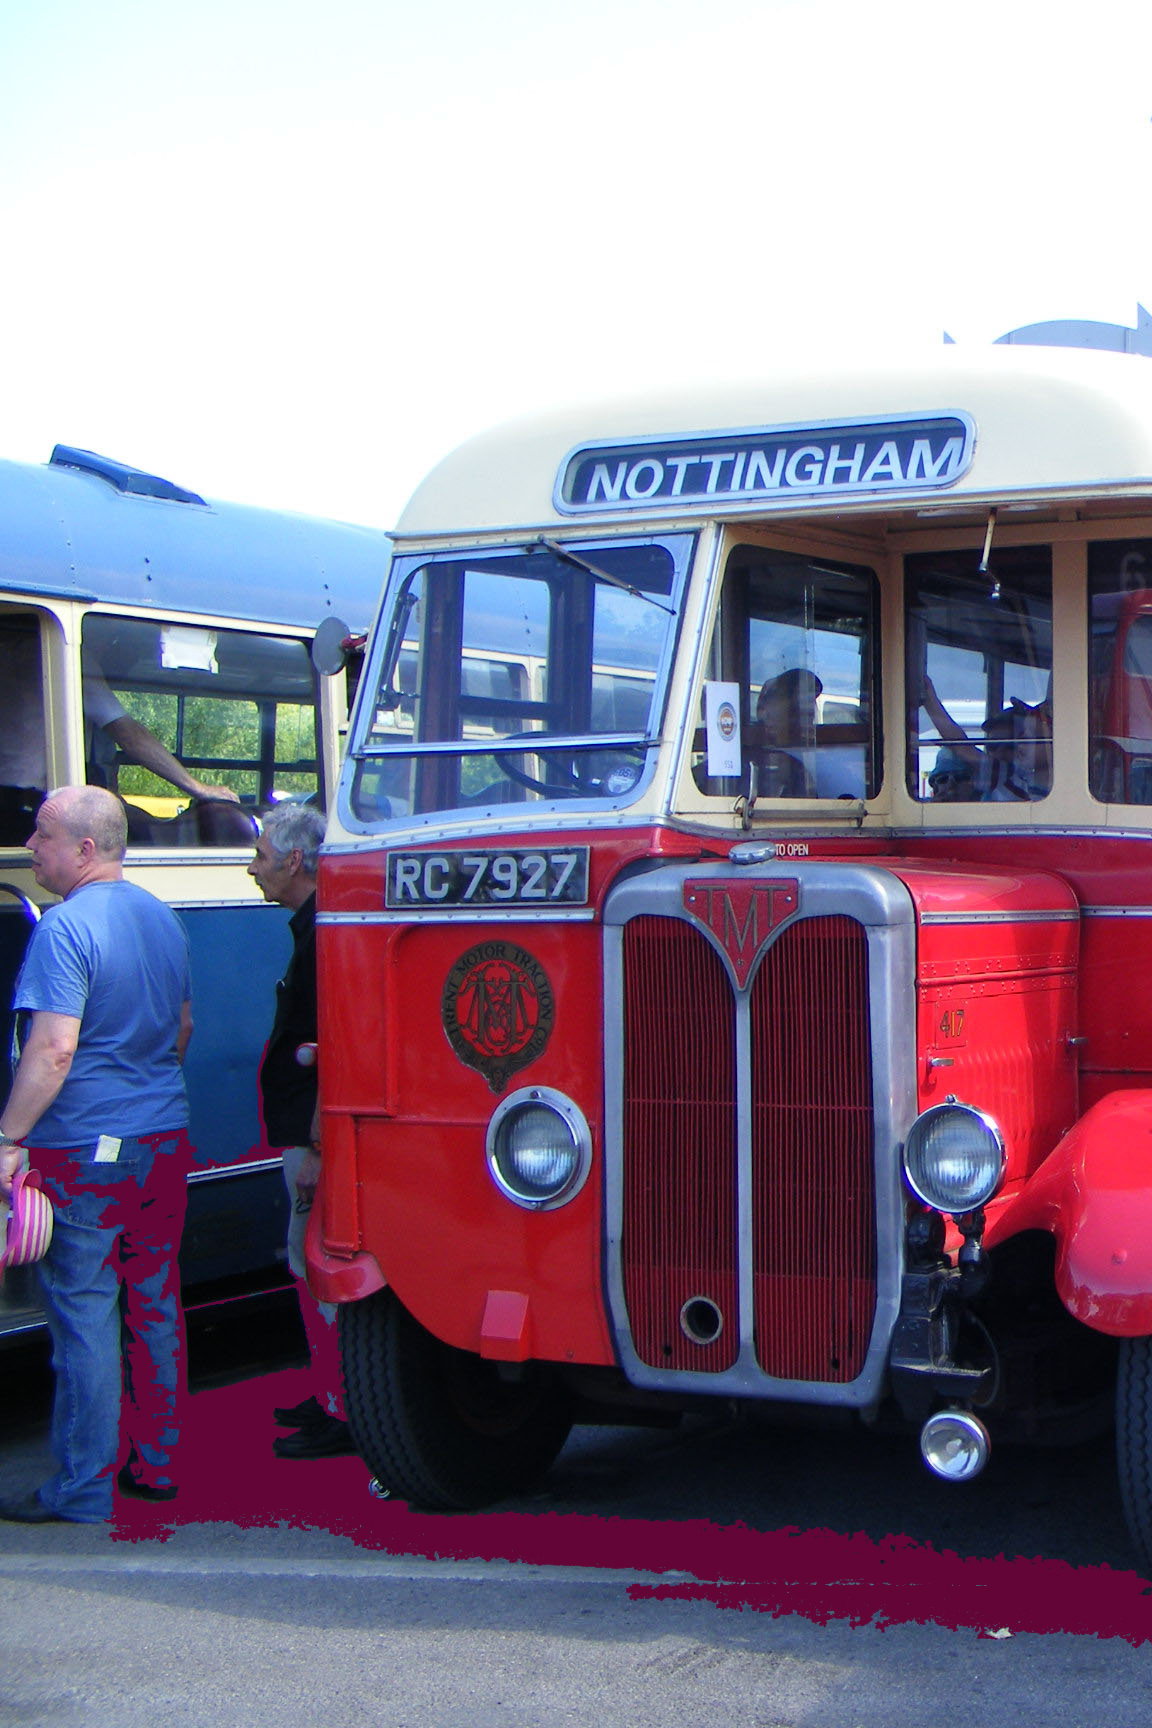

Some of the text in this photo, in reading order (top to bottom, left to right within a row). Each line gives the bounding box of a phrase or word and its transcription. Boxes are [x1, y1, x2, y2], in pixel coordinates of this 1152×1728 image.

[587, 437, 963, 502] NOTTINGHAM
[395, 854, 578, 899] RC 7927
[775, 843, 809, 856] TO OPEN
[694, 885, 789, 954] TMT
[456, 943, 507, 974] MOTOR
[513, 949, 552, 1021] TRACTION
[939, 1009, 965, 1039] 417
